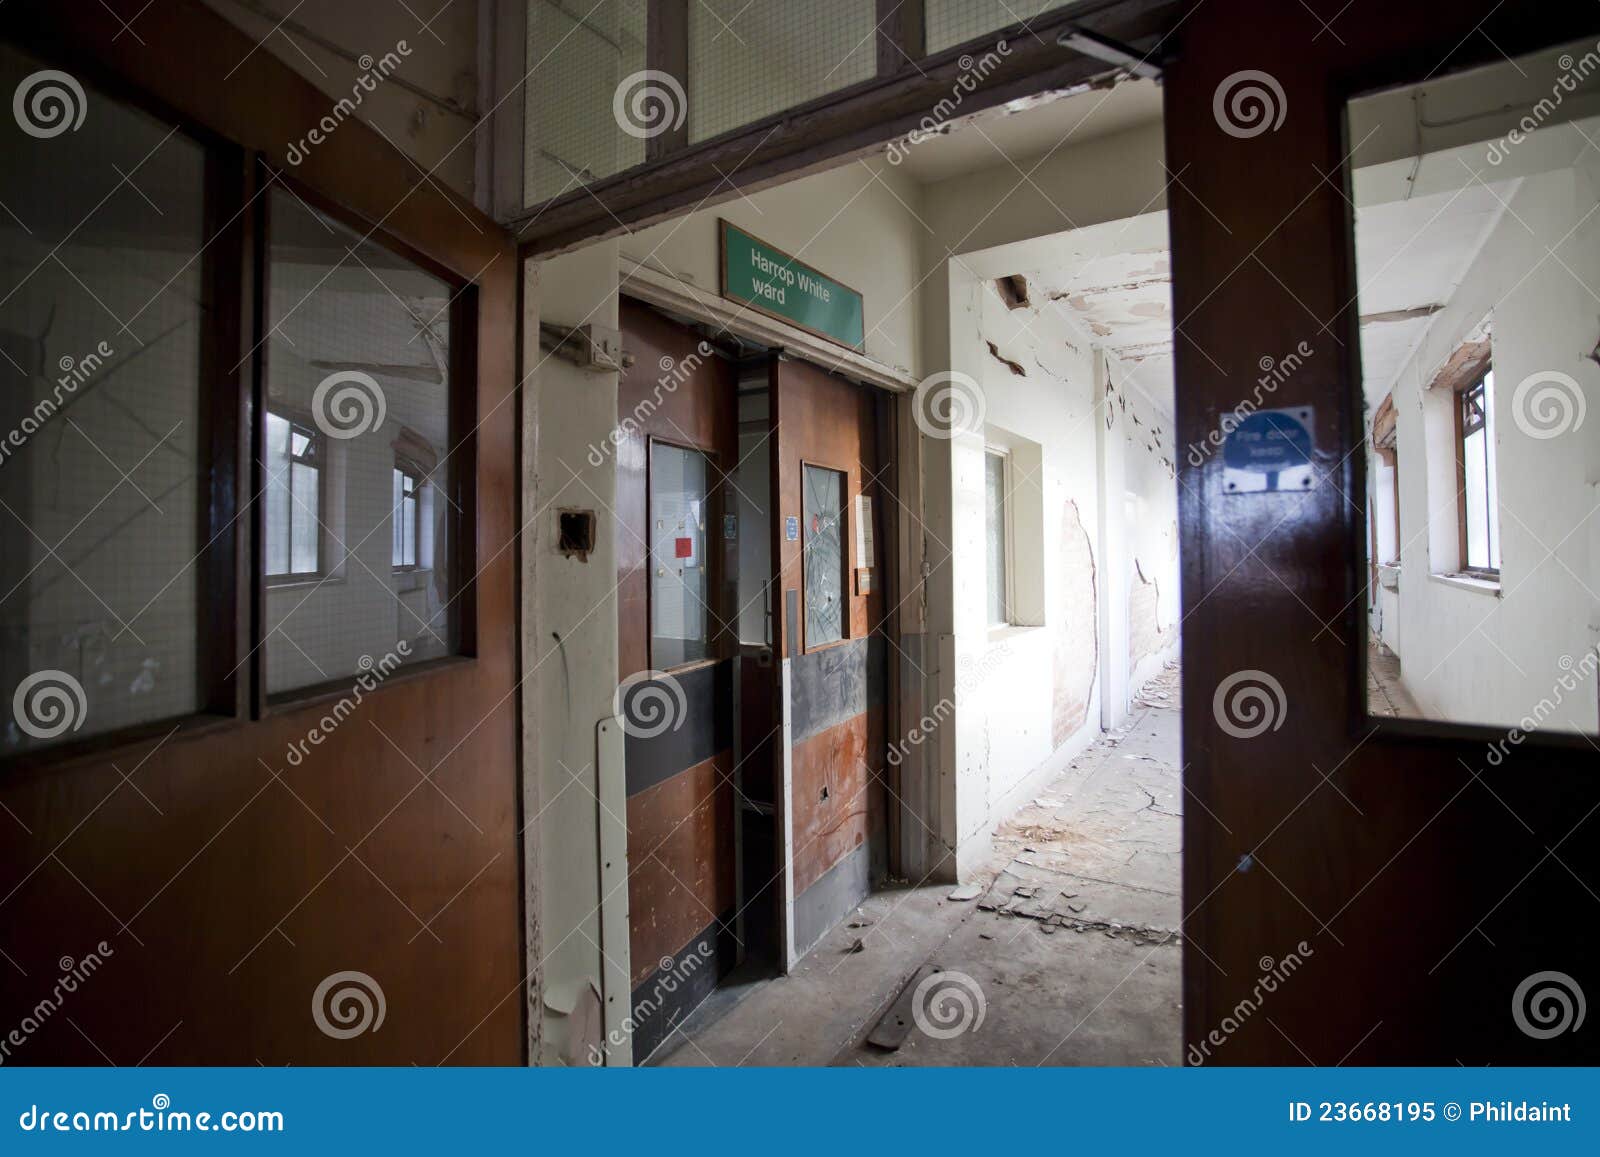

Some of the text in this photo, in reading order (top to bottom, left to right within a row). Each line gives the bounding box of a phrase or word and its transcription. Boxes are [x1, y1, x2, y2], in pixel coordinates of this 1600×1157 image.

[751, 247, 831, 303] Harrop White
[752, 277, 786, 305] ward
